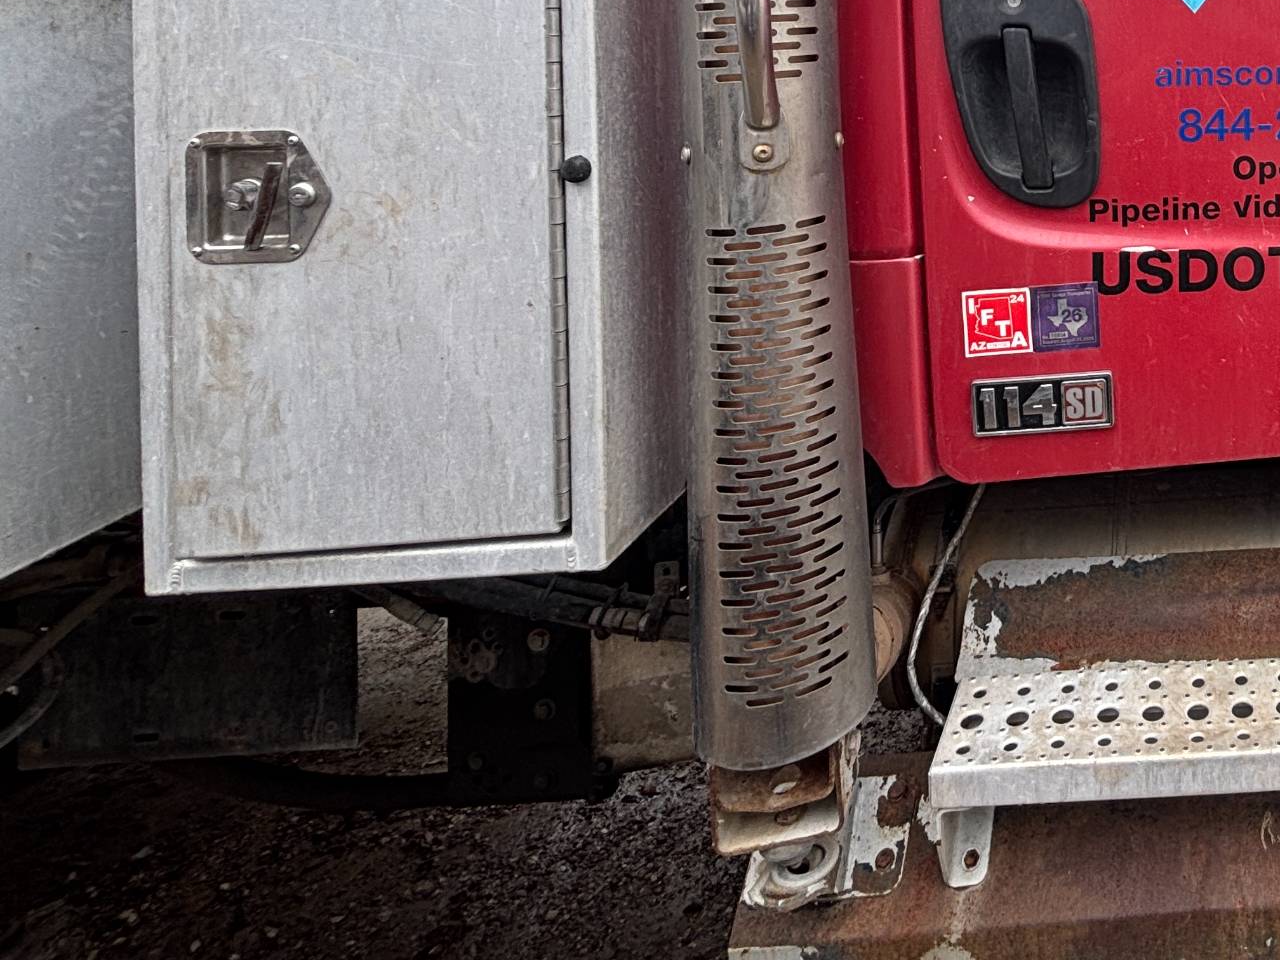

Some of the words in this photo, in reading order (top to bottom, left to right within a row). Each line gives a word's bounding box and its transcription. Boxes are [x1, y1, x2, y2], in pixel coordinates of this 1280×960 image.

[1088, 195, 1221, 225] Pipeline
[1010, 294, 1025, 304] 24
[1061, 308, 1083, 324] 26
[970, 341, 987, 351] AZ
[978, 383, 1058, 430] 114
[1065, 386, 1104, 420] SD
